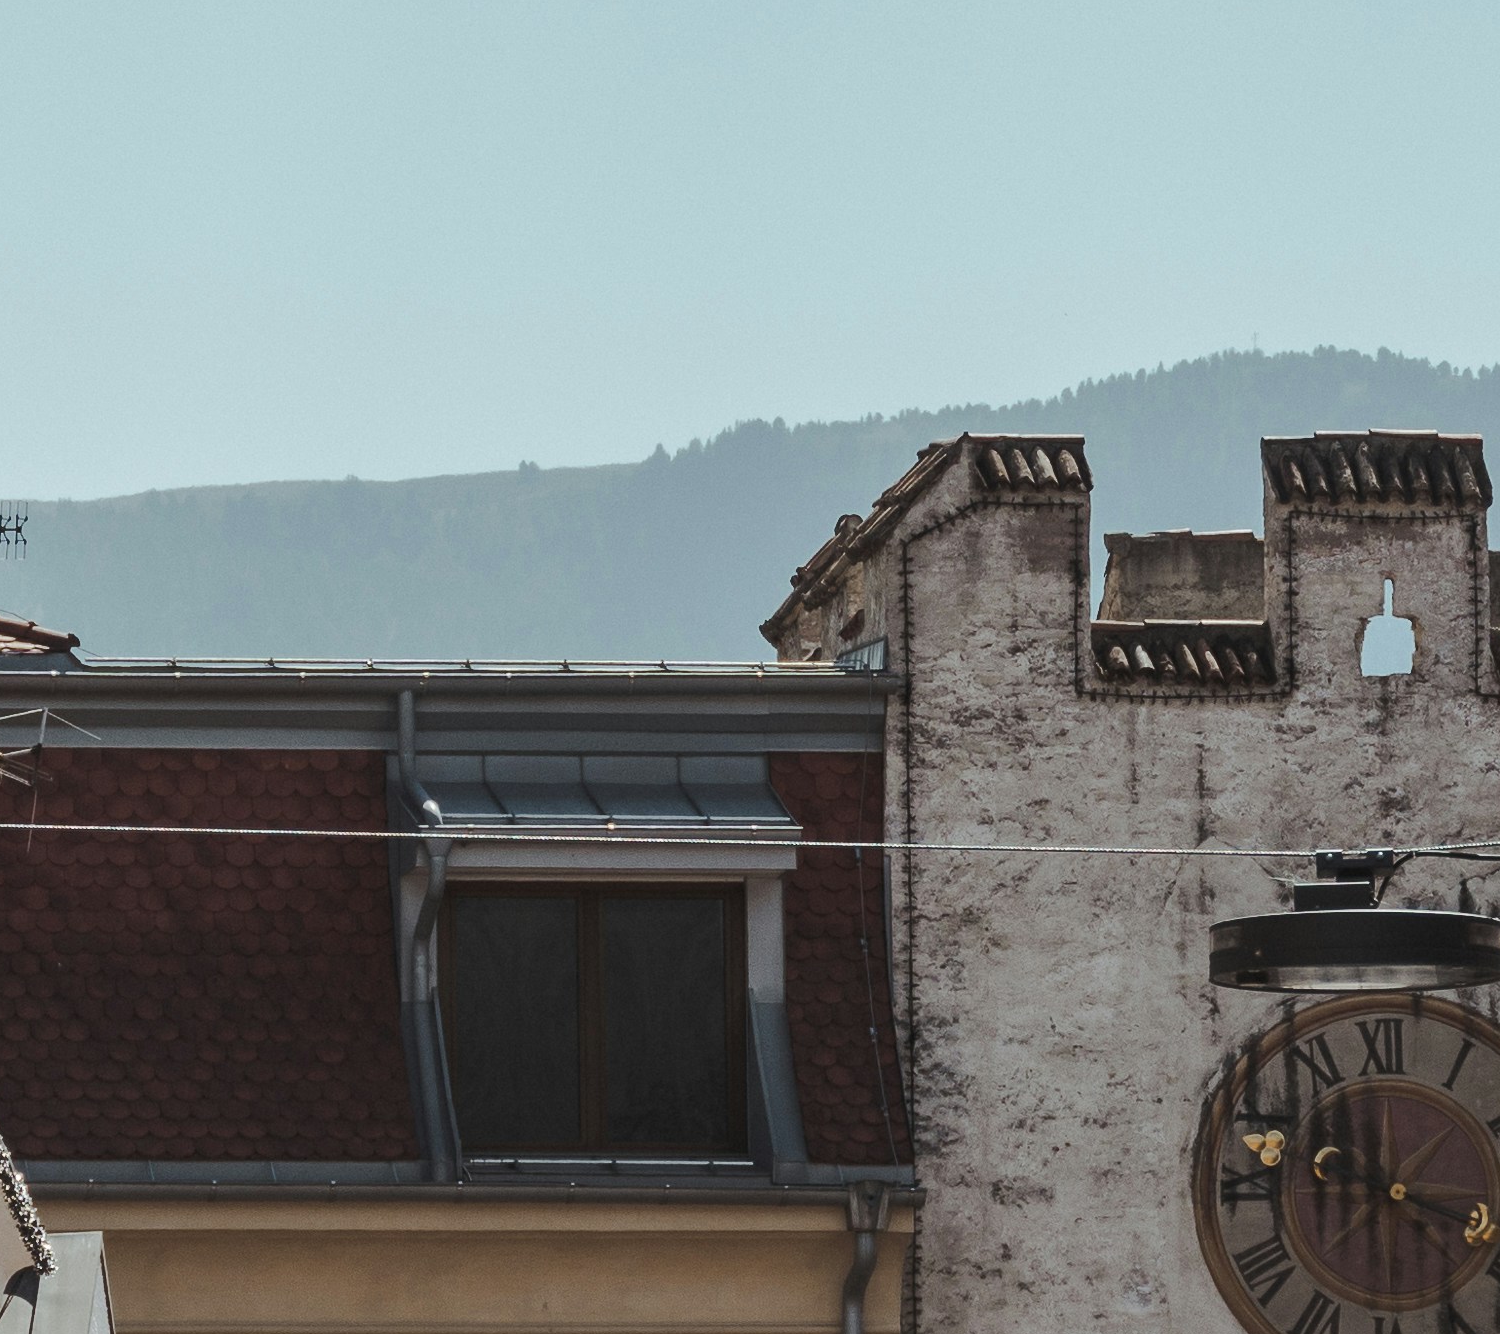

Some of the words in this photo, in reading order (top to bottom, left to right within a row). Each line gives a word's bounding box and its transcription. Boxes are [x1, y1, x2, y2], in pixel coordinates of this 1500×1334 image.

[1290, 1032, 1346, 1097] XI
[1355, 1018, 1406, 1076] XII
[1442, 1038, 1477, 1092] I
[1233, 1237, 1297, 1308] VIII
